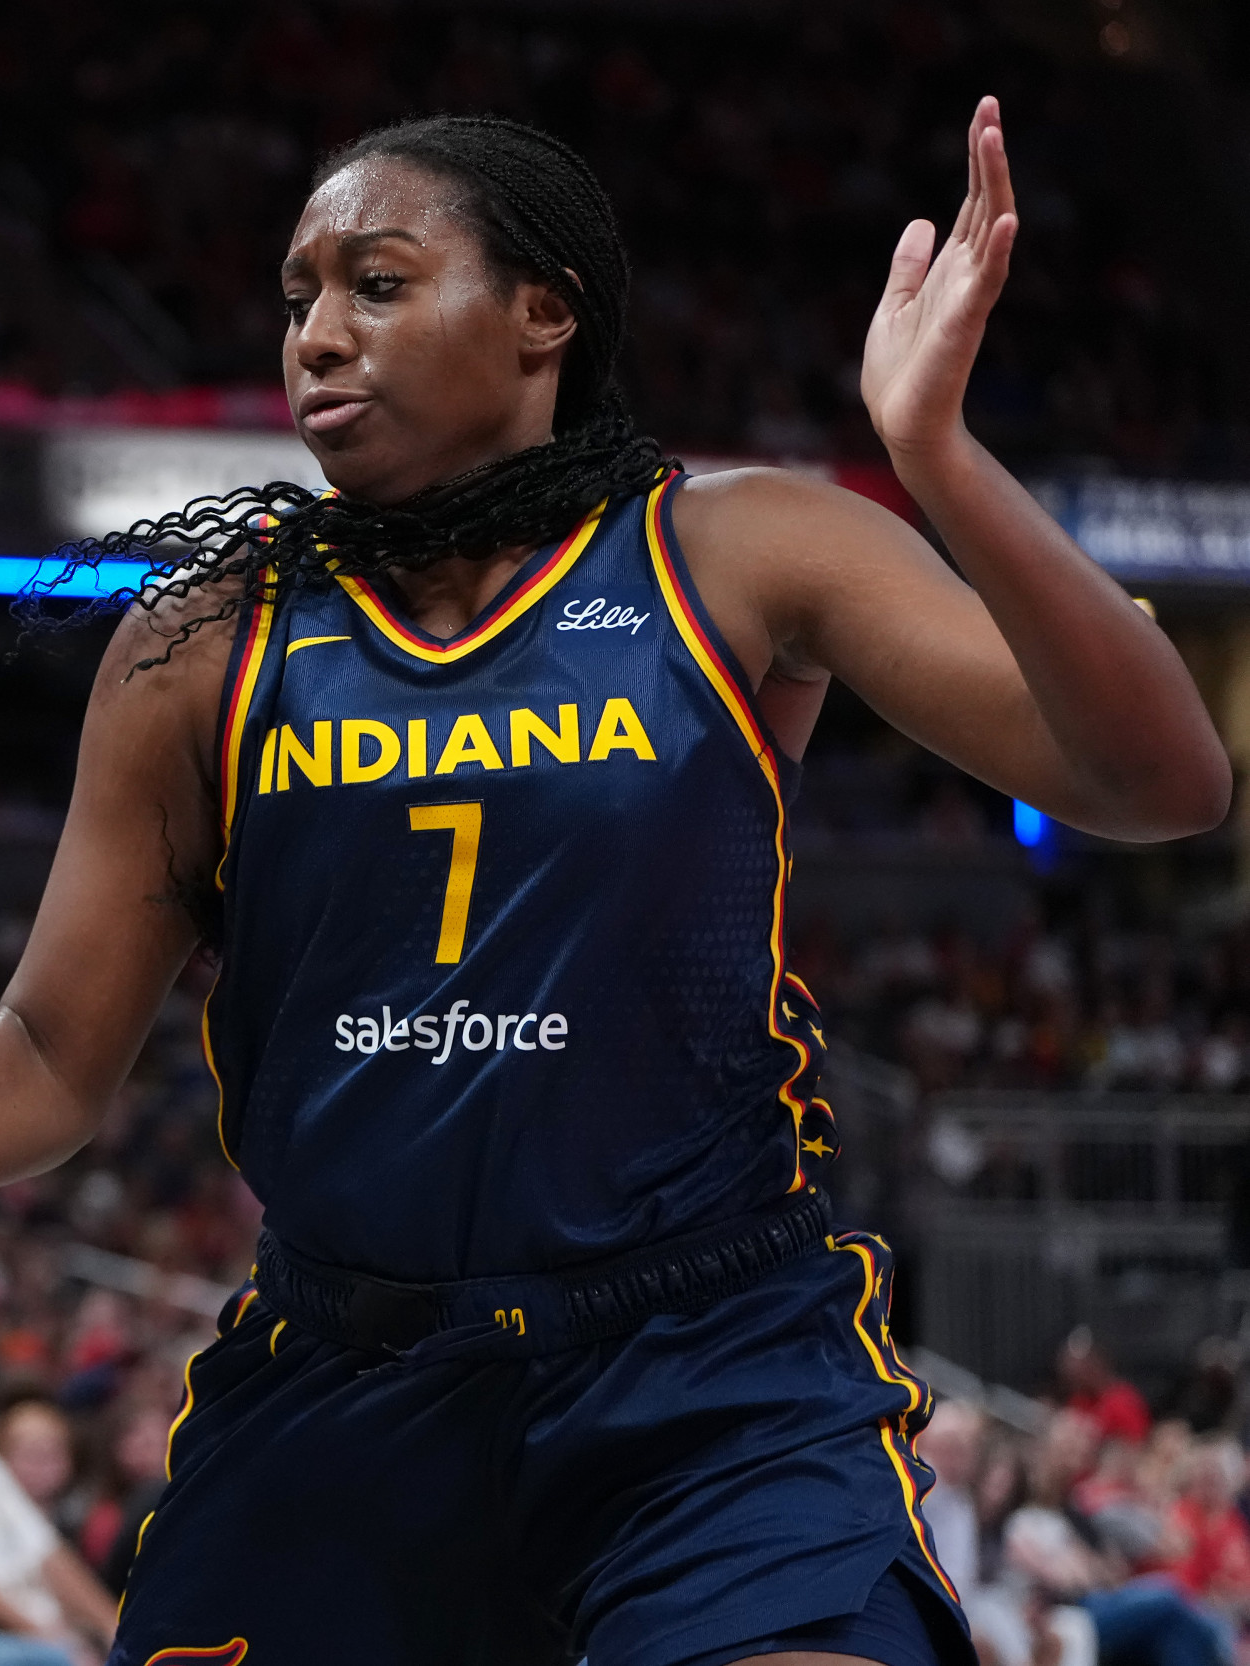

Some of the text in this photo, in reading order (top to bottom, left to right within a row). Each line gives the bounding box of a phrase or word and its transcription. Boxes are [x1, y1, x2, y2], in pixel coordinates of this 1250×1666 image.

[556, 597, 651, 635] Lilly
[258, 697, 658, 796] INDIANA
[405, 799, 486, 965] 7
[334, 999, 569, 1065] salesforce
